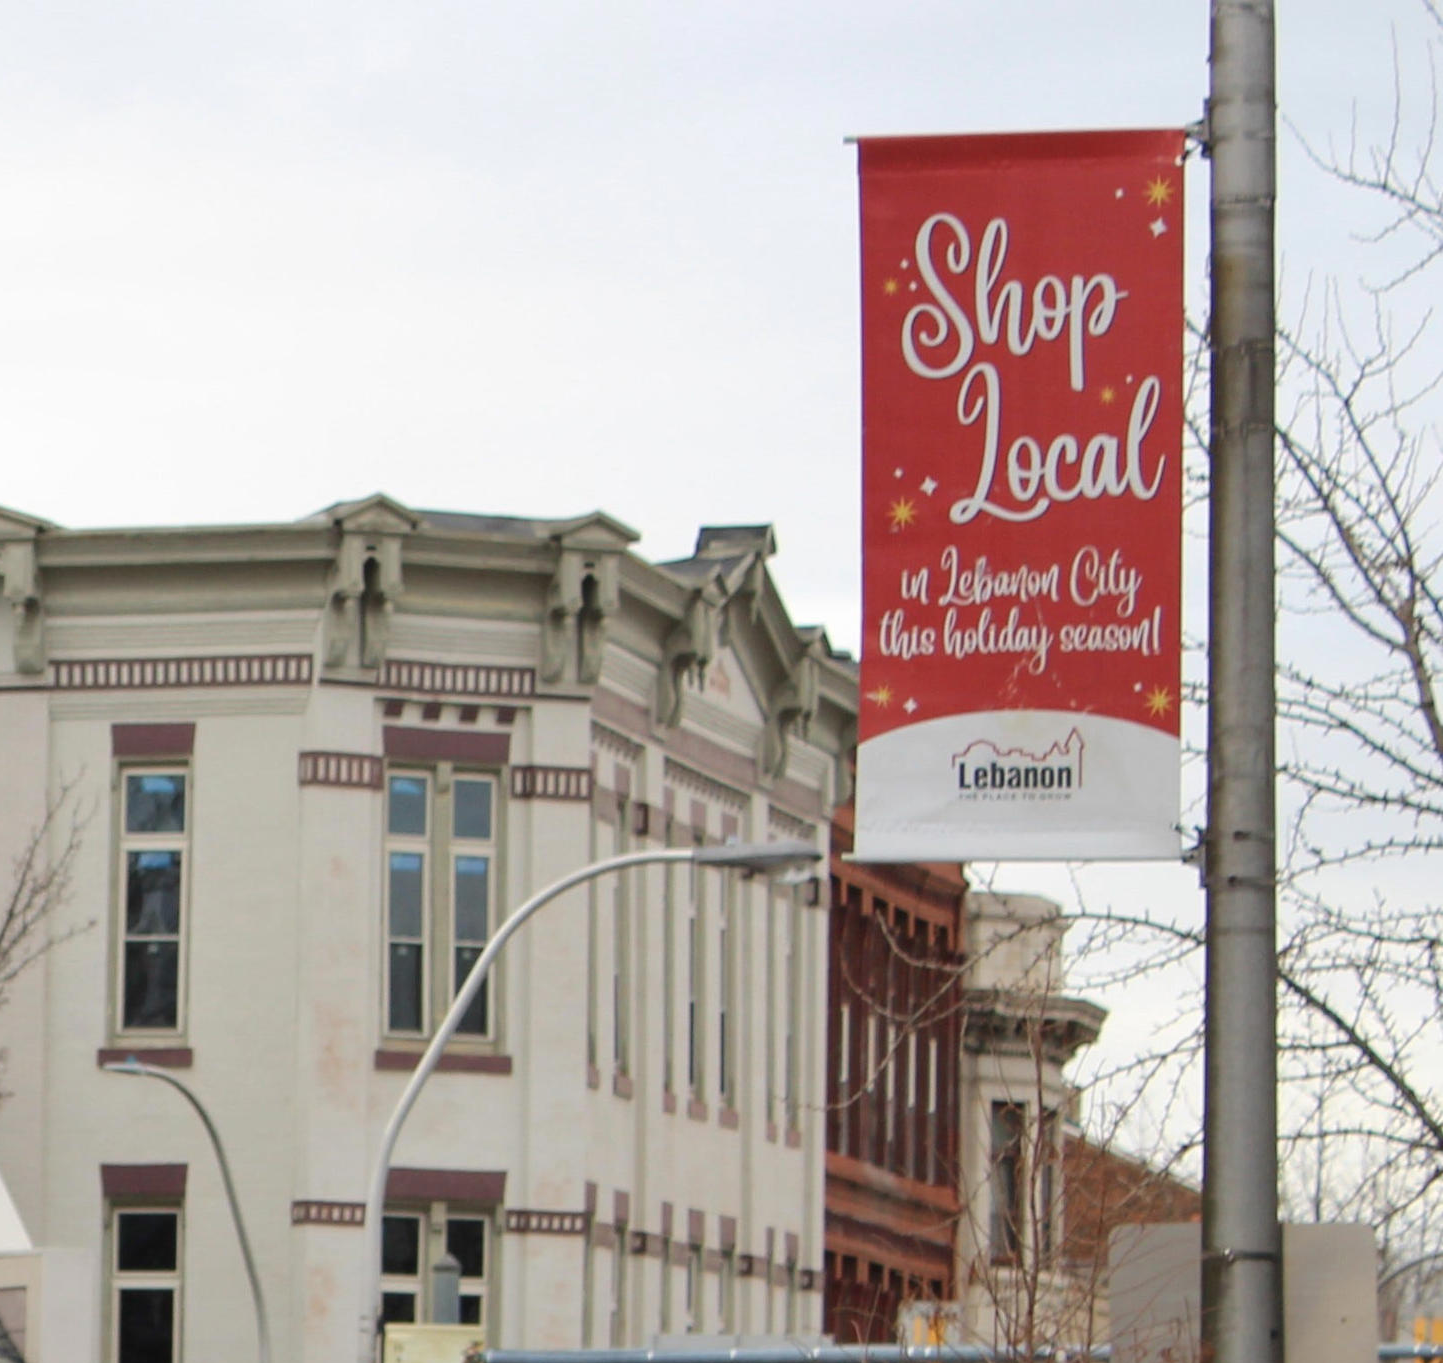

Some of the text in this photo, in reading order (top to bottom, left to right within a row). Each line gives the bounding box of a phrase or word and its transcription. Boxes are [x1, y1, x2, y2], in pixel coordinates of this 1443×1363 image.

[901, 212, 1128, 392] Shop
[948, 361, 1166, 525] Local
[900, 544, 1144, 619] in Lebanon City
[879, 605, 1162, 676] this holiday season!
[958, 762, 1072, 789] Lebanon
